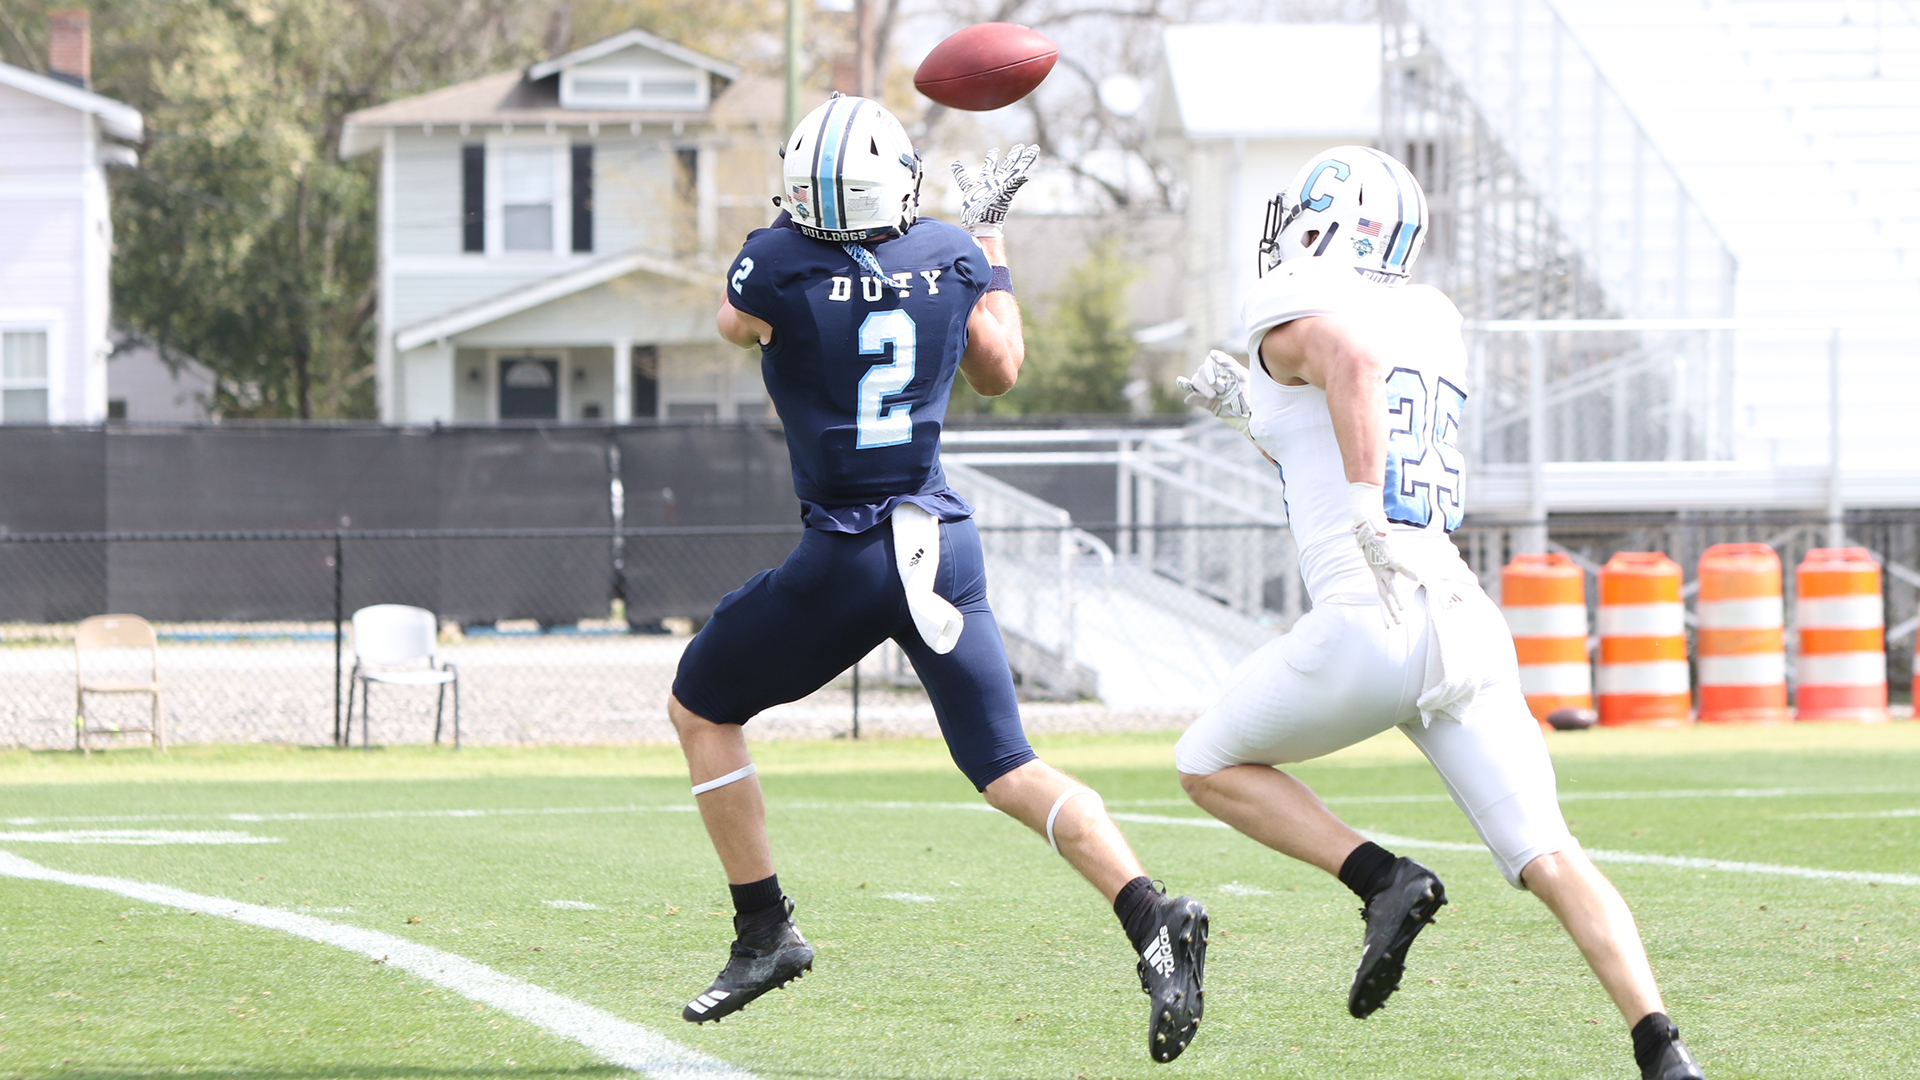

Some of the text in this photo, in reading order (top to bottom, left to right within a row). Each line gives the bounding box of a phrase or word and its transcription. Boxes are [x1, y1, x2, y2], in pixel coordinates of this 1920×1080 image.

[1300, 158, 1351, 213] C
[801, 225, 867, 242] BULLDOGS
[731, 256, 755, 295] 2
[828, 269, 942, 302] DUTY
[856, 308, 917, 450] 2
[1383, 366, 1468, 534] 25
[1159, 924, 1175, 979] adidas
